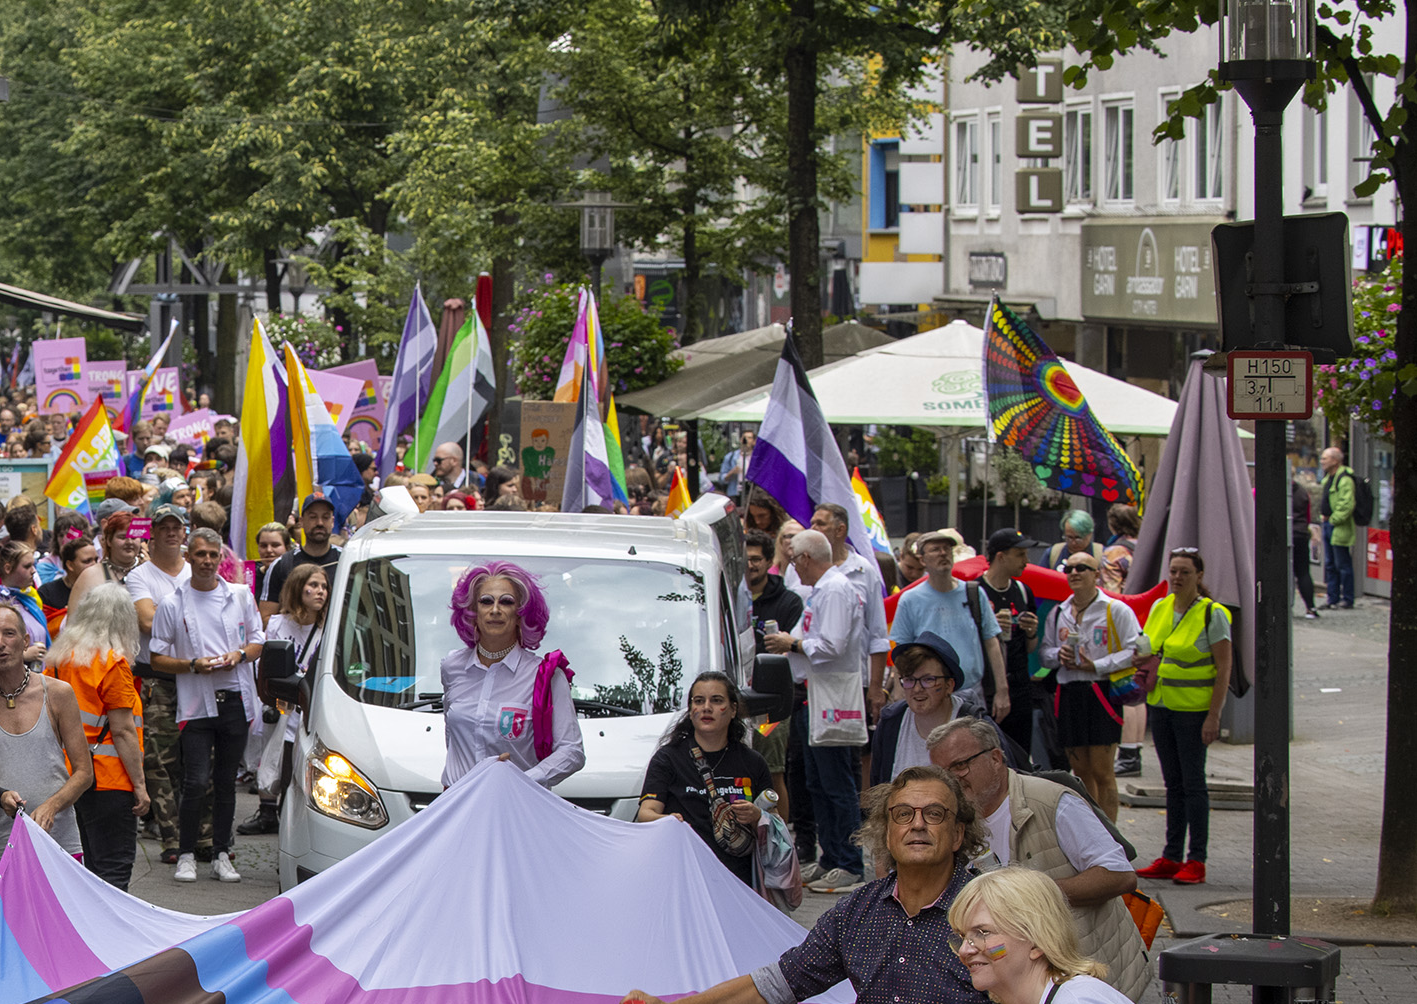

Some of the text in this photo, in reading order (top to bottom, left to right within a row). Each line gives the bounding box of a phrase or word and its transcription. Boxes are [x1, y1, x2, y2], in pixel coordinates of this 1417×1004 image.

[88, 370, 124, 382] TRONG
[130, 373, 177, 395] LVE
[171, 418, 211, 441] TRONG
